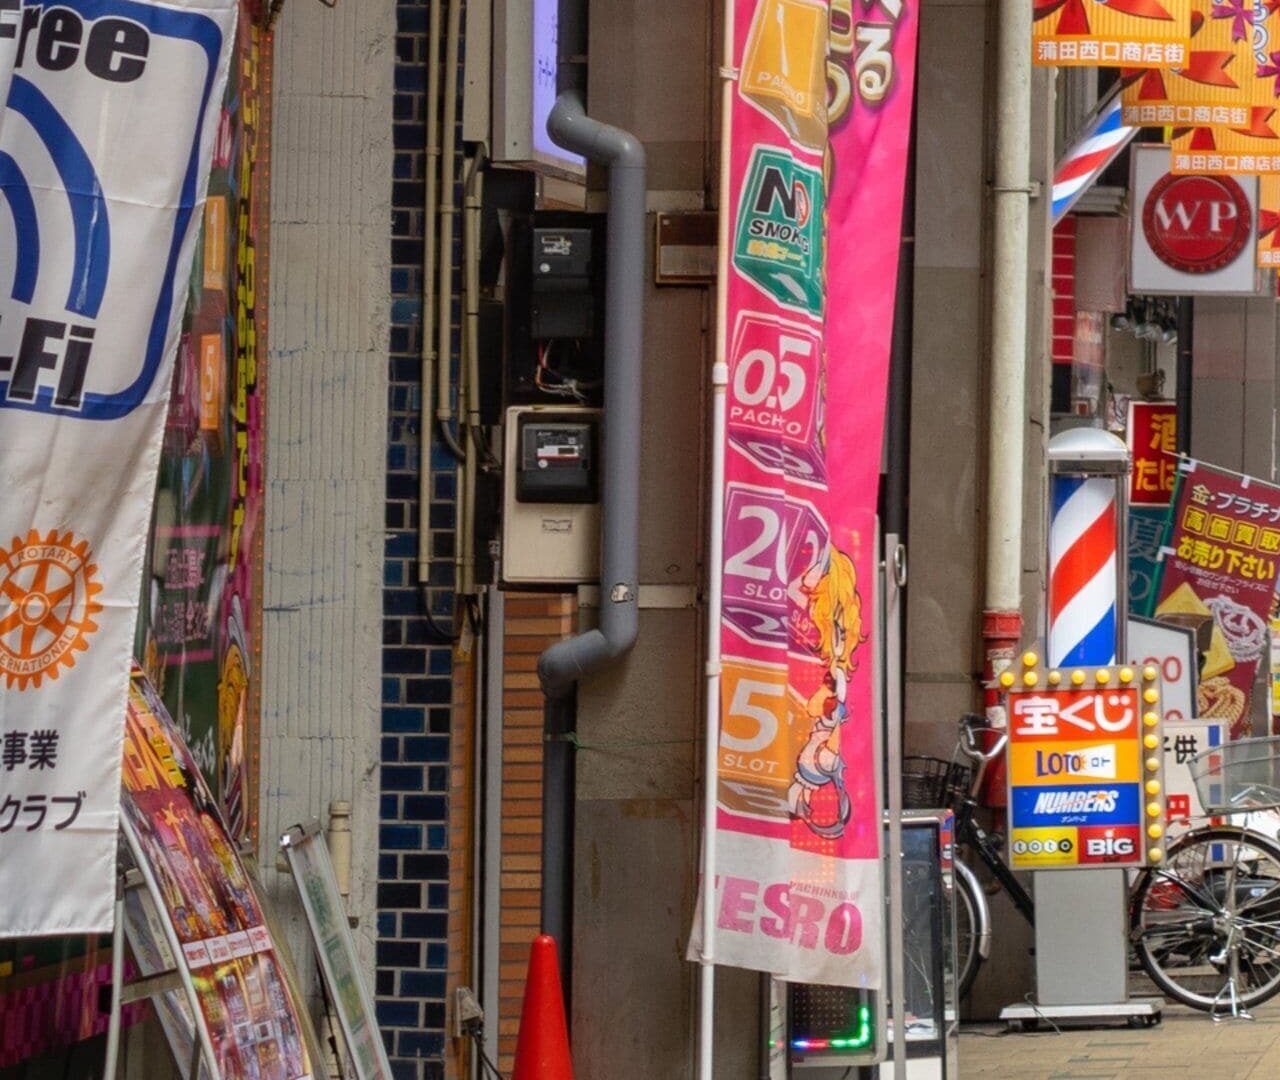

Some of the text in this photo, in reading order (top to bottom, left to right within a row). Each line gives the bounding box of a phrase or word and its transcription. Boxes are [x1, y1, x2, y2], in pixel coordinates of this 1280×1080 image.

[1037, 38, 1185, 65] 蒲田西口商店街
[1122, 103, 1248, 124] 蒲田西口商店街
[1175, 534, 1276, 581] お売り下さい
[1012, 693, 1135, 736] 宝くじ
[722, 752, 780, 775] SLOT
[1035, 748, 1081, 777] LOTO
[1032, 789, 1121, 816] NUMBERS
[1012, 838, 1074, 856] toto
